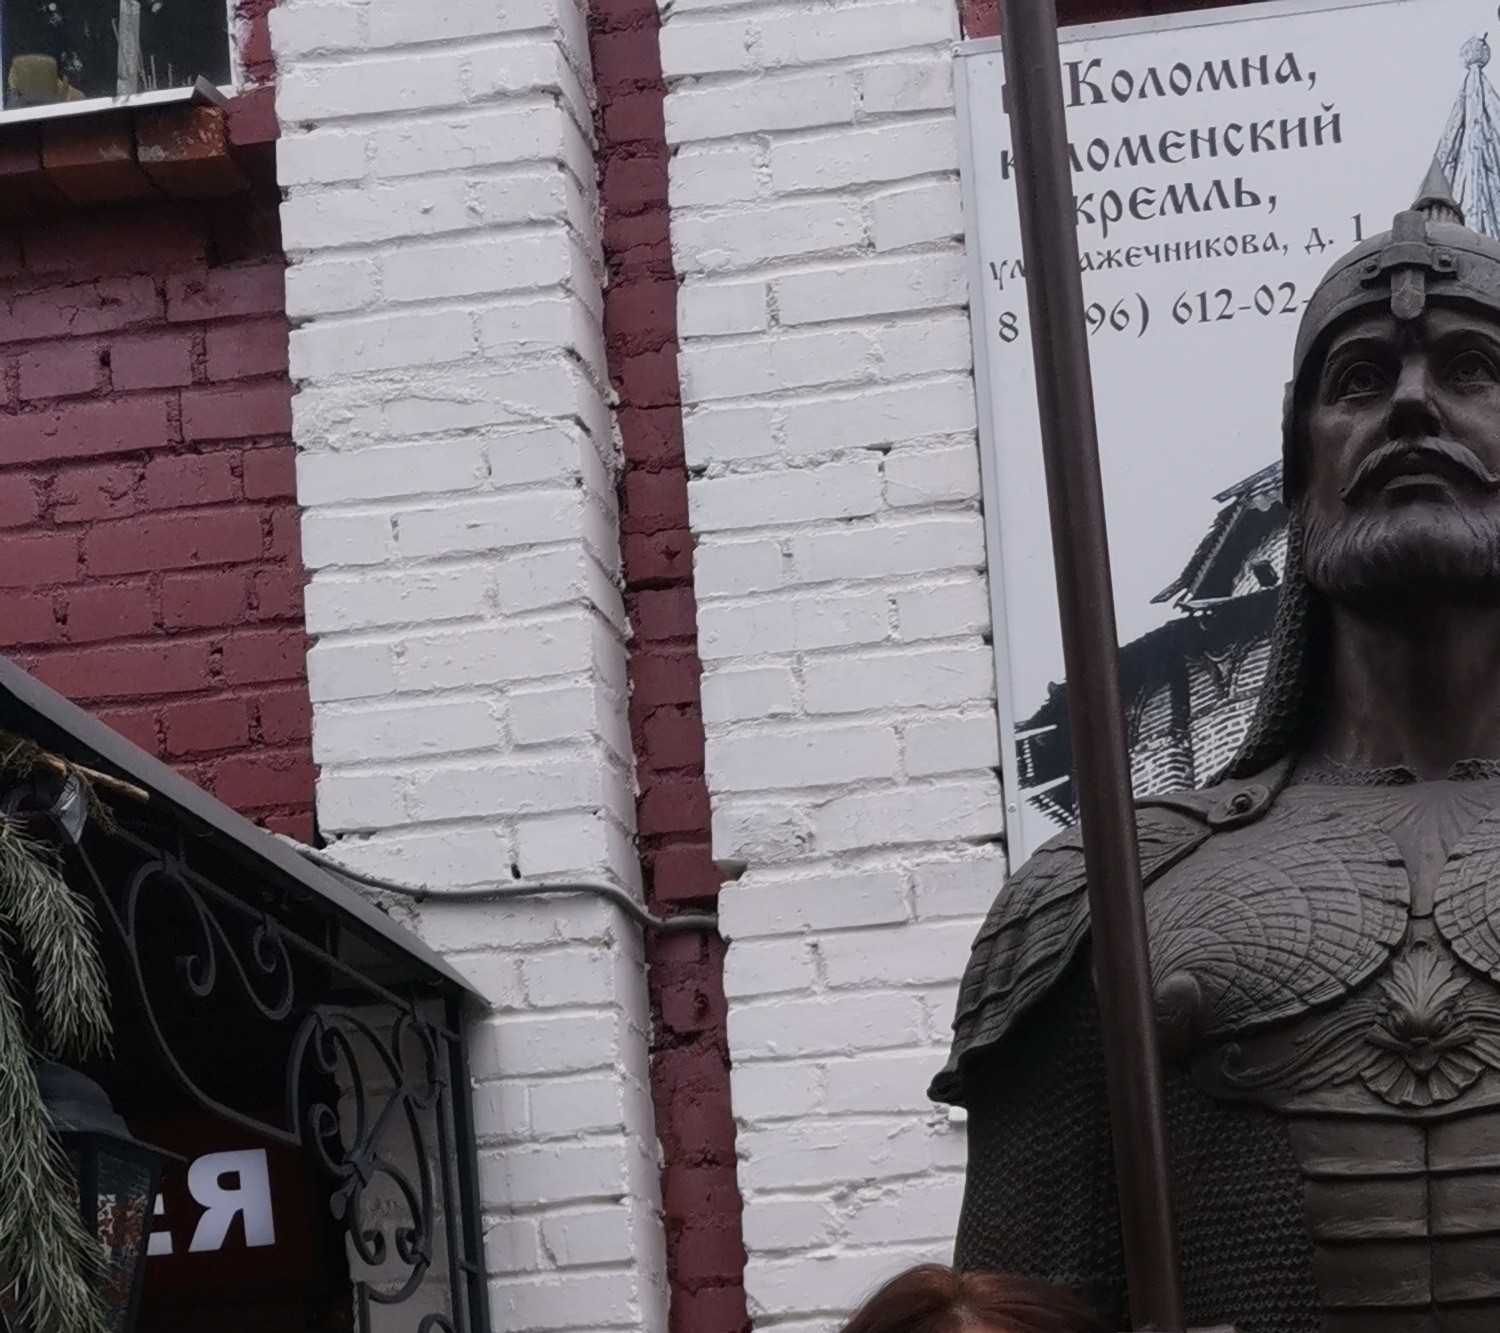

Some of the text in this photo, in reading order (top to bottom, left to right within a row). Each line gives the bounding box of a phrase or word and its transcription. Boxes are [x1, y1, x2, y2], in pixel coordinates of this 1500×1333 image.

[1063, 51, 1318, 108] Коломна,
[1072, 176, 1278, 239] кремль,
[1079, 230, 1290, 274] ажечникова,
[1304, 226, 1335, 255] д.
[998, 281, 1310, 343] 8 96) 612-02-
